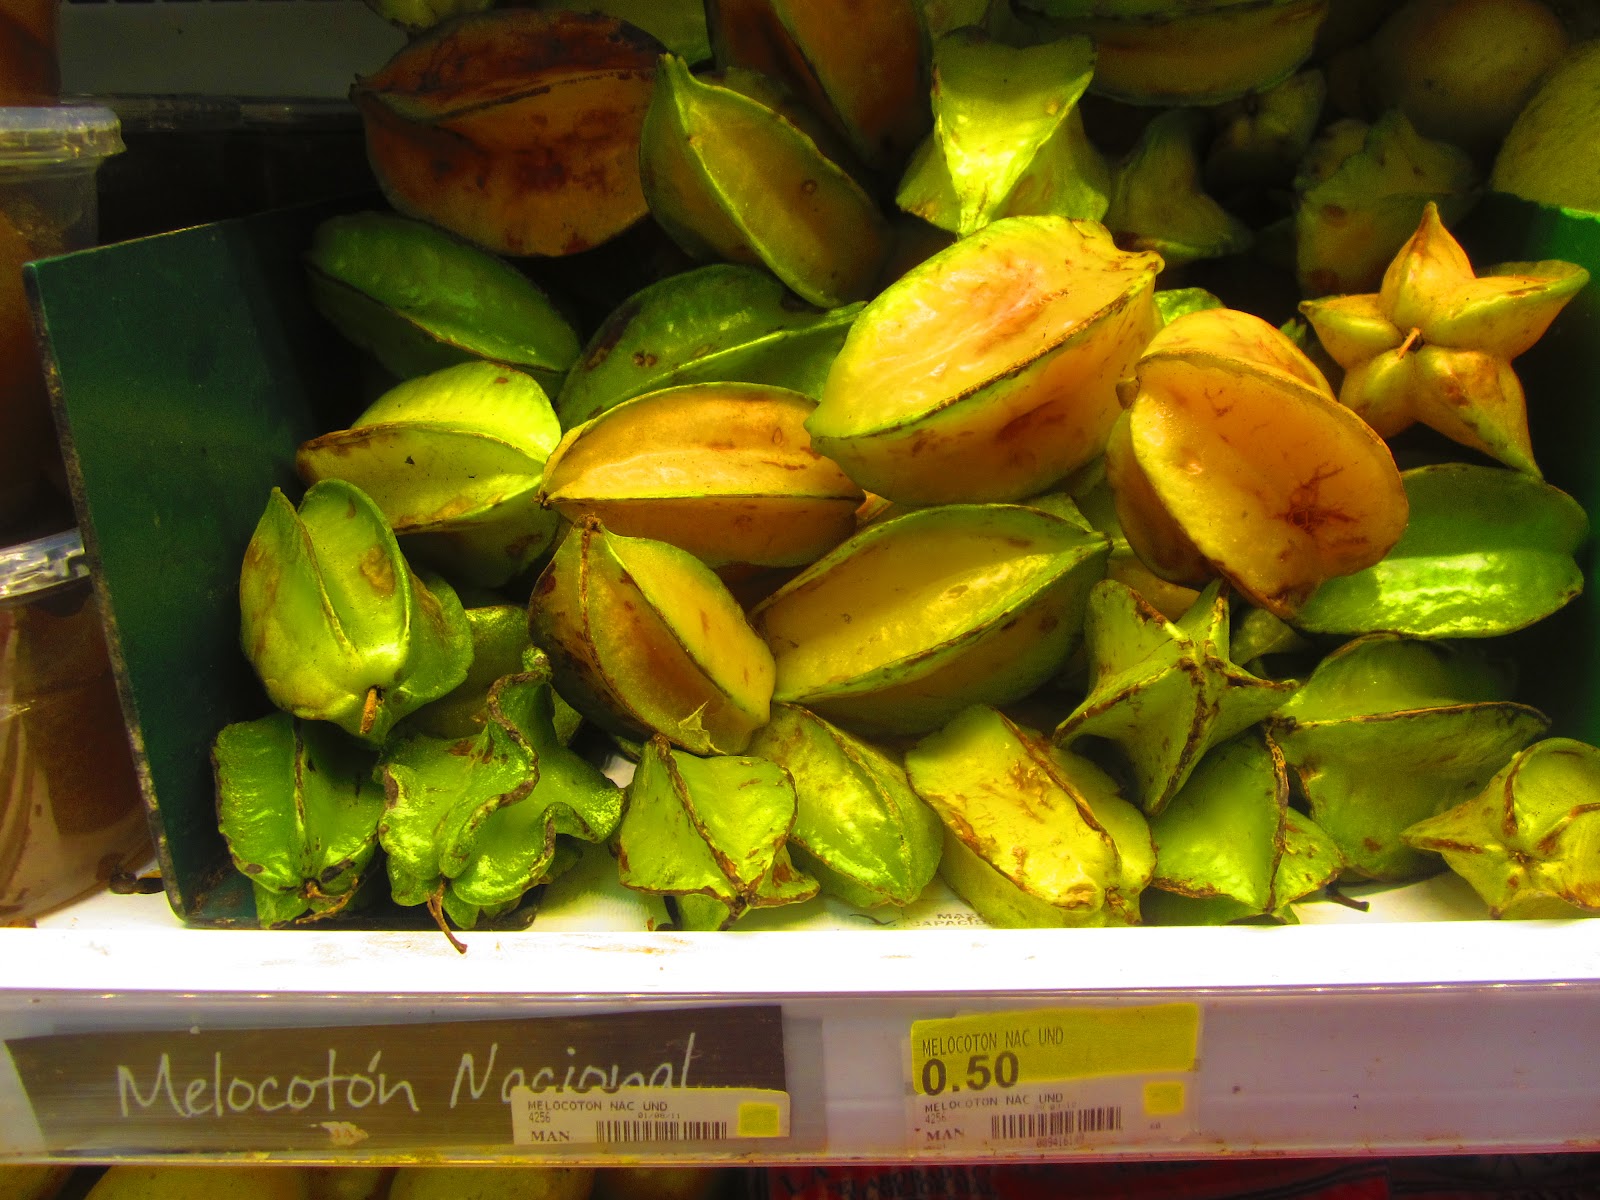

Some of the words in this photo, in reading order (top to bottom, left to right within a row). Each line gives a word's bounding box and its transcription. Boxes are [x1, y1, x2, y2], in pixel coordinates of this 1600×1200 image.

[922, 1033, 998, 1057] MELOCOTON
[1005, 1029, 1031, 1048] NAC
[1038, 1026, 1064, 1046] UND
[921, 1051, 1020, 1096] 0.50
[117, 1048, 420, 1118] Melocotón
[527, 1100, 602, 1111] MELOCOTON
[610, 1101, 635, 1111] NAC
[643, 1101, 668, 1111] UND
[1006, 1094, 1031, 1106] NAC
[1038, 1092, 1063, 1104] UND
[528, 1111, 551, 1123] 4256
[531, 1130, 570, 1142] MAN
[927, 1127, 965, 1142] MAN
